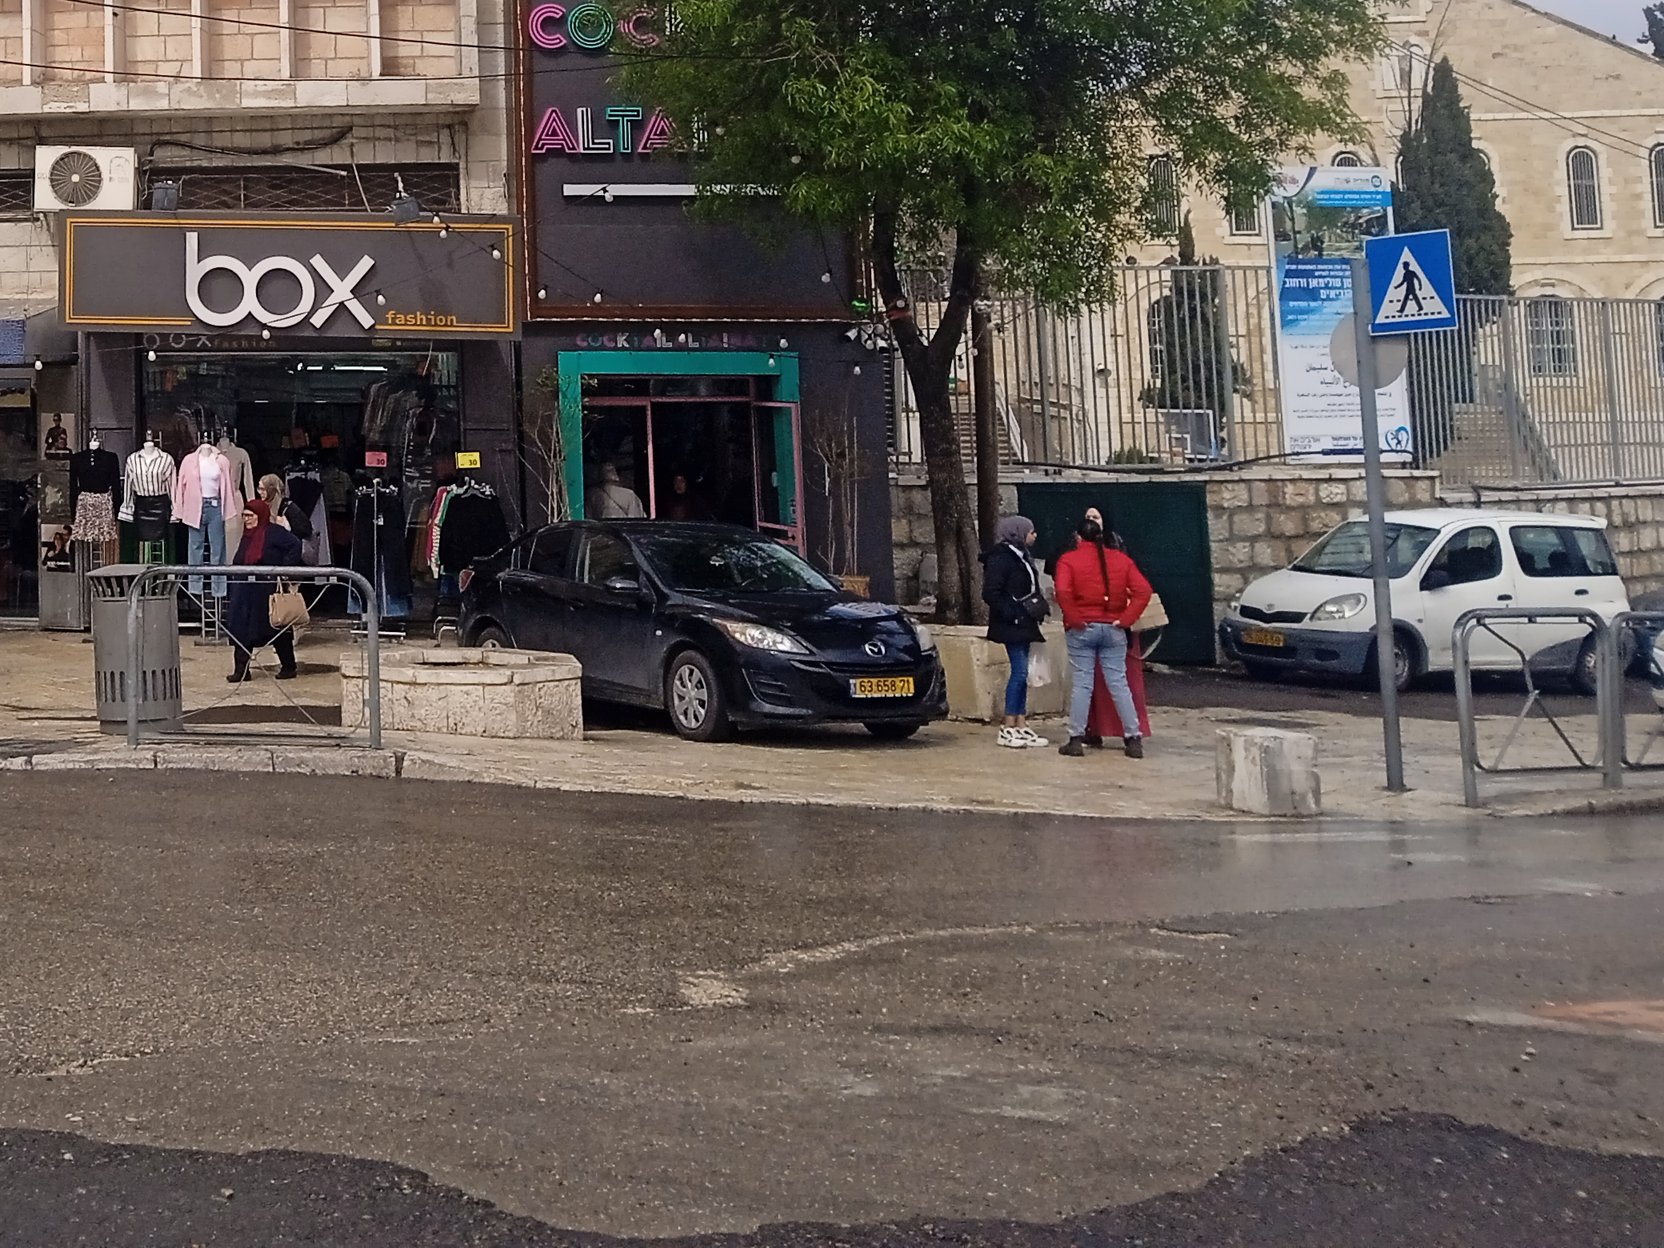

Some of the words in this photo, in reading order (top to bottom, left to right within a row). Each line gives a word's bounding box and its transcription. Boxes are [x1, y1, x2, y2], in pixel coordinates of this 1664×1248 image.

[185, 231, 376, 328] box
[385, 309, 458, 327] fashion
[859, 680, 874, 693] 63
[877, 679, 897, 693] 658
[899, 678, 911, 693] 71
